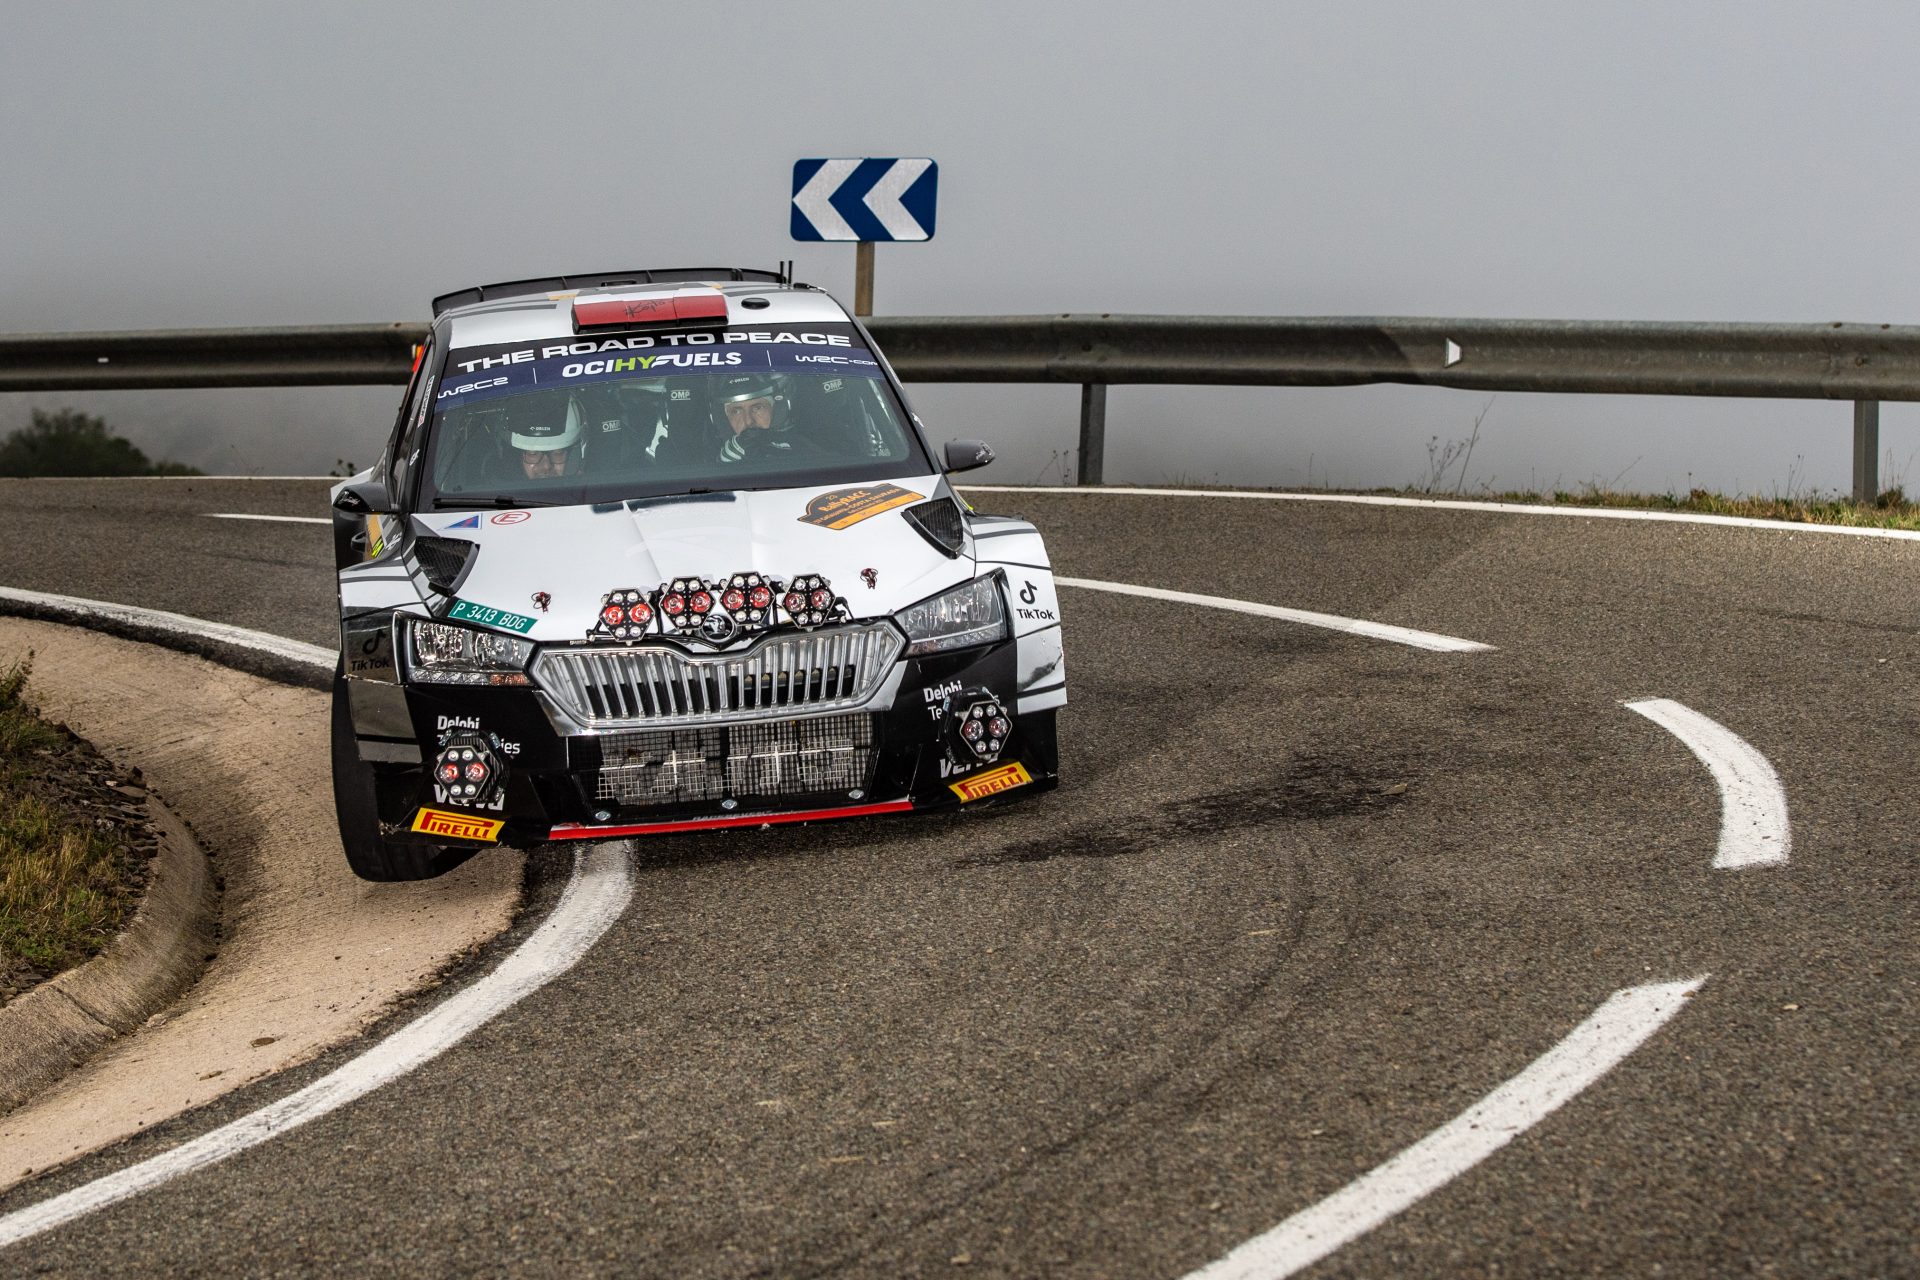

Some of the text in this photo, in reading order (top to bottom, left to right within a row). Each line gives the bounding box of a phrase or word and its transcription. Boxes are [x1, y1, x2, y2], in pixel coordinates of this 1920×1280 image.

[458, 332, 851, 373] THE ROAD TO PEACE
[671, 390, 690, 400] OMP
[824, 380, 843, 392] OMP
[453, 603, 527, 630] P 3413 BDG
[1016, 608, 1055, 620] TikTok
[351, 657, 389, 671] TikTok
[958, 766, 1025, 800] PIRELLI
[420, 811, 495, 838] PIRELLI
